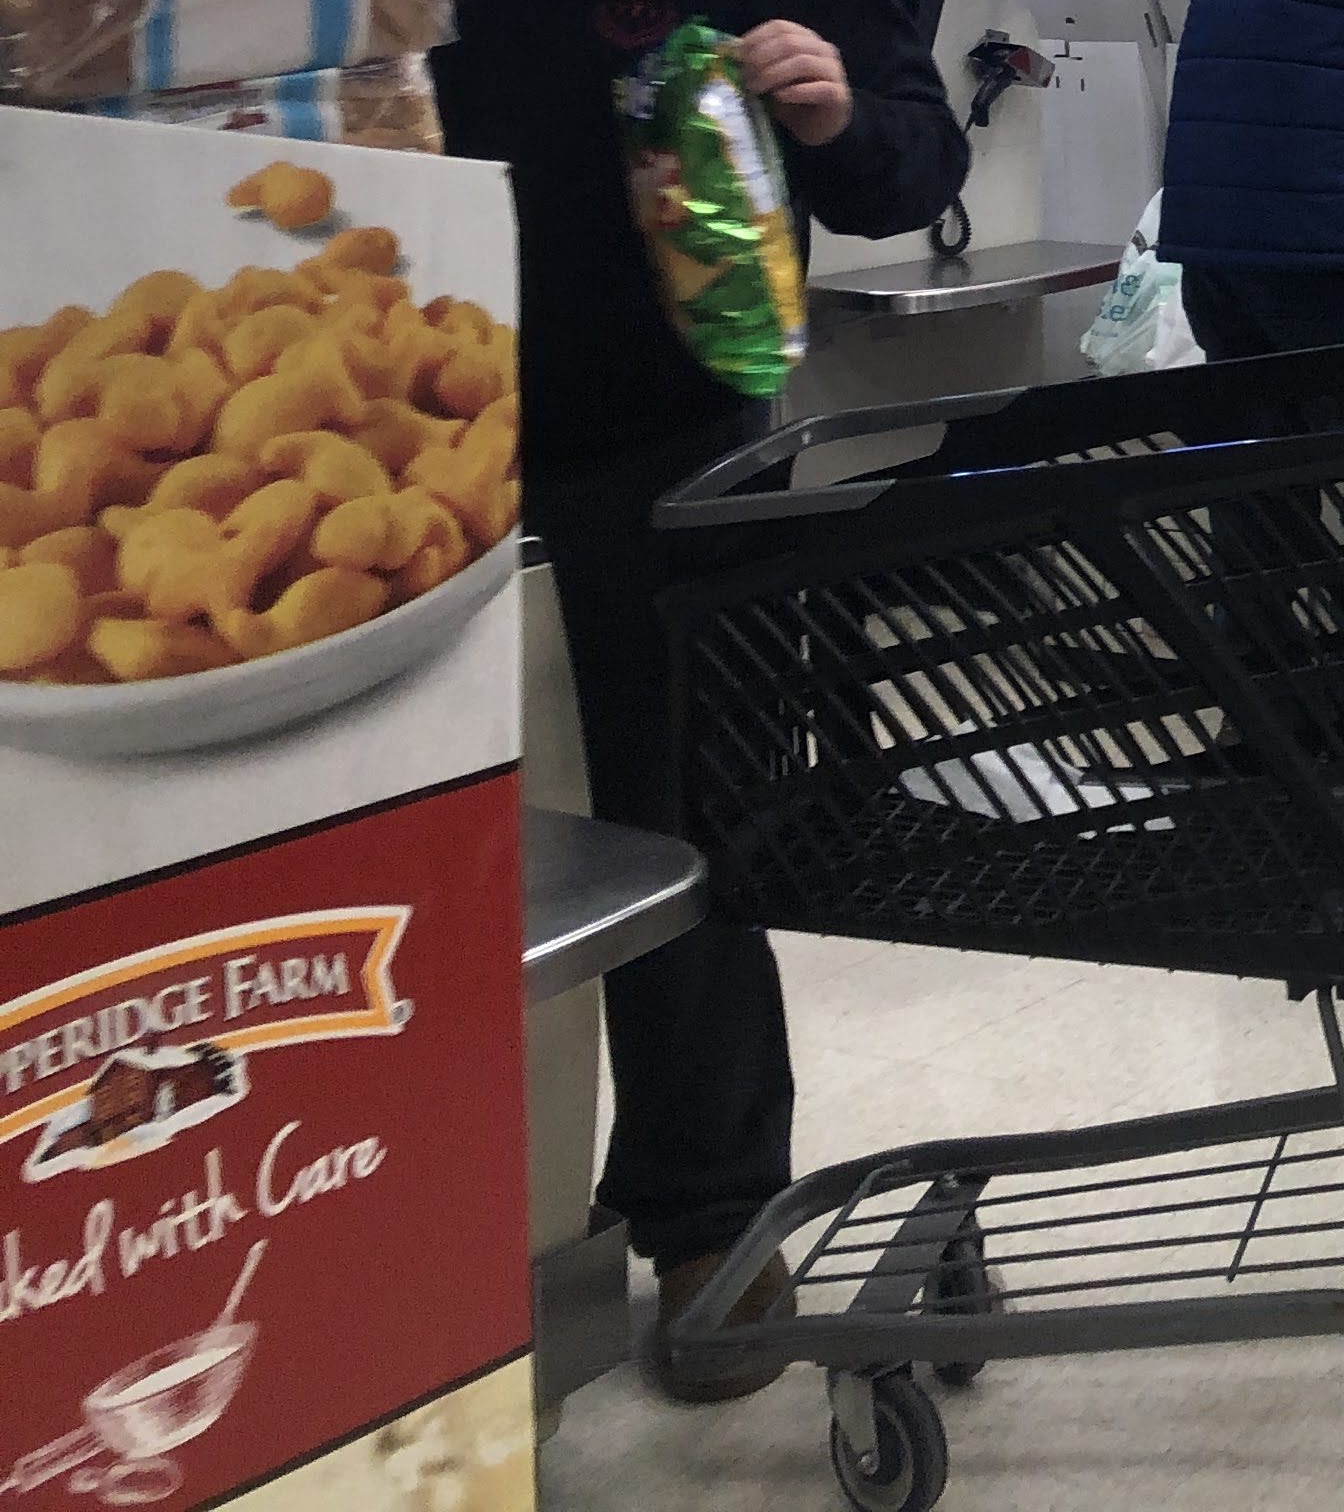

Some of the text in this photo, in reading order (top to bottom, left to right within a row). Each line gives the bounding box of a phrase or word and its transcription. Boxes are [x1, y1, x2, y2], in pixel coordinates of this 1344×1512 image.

[0, 951, 353, 1096] PERIDGE FARM
[119, 1148, 249, 1278] with
[256, 1120, 389, 1217] Care
